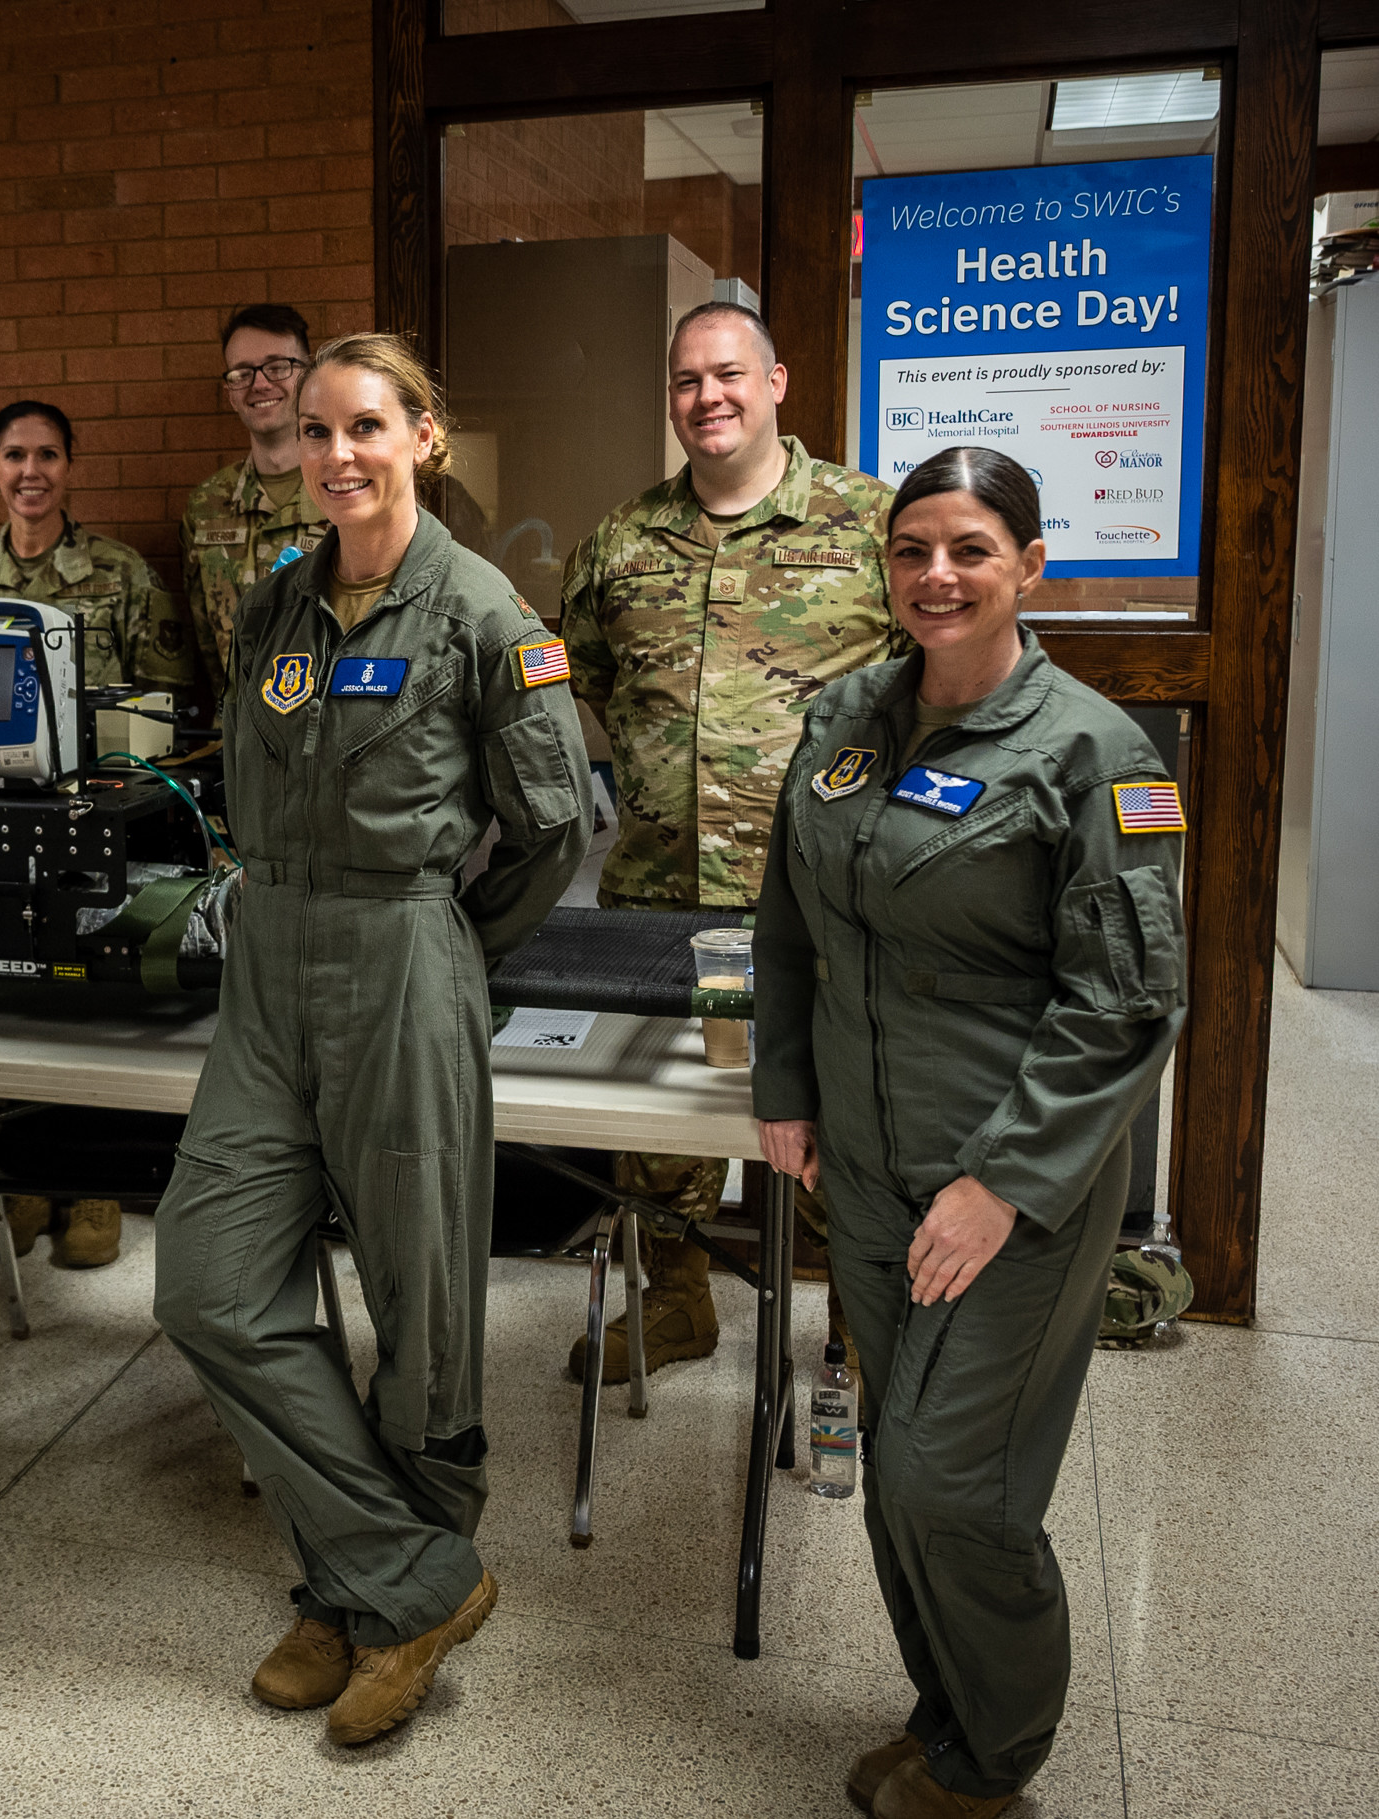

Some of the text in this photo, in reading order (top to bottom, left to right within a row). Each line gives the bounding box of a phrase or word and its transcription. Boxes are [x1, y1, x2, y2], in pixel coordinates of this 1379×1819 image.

[892, 201, 1025, 231] Welcome
[1035, 197, 1062, 221] to
[956, 238, 1107, 284] Health
[885, 286, 1179, 336] Science Day!
[897, 359, 1166, 383] This event is proudly sponsored by:
[1050, 402, 1160, 414] SCHOOL OF NURSING
[892, 412, 919, 428] BJC
[927, 409, 1014, 425] HealthCare
[927, 425, 1019, 438] Memorial Hospital
[1040, 419, 1170, 431] SOUTHERN ILLINOIS UNIVERSITY
[1070, 430, 1138, 439] EDWARDSVILLE
[1119, 456, 1163, 468] MANOR
[1095, 531, 1150, 540] Touchette
[799, 551, 817, 563] AIR
[821, 551, 856, 565] FORCE
